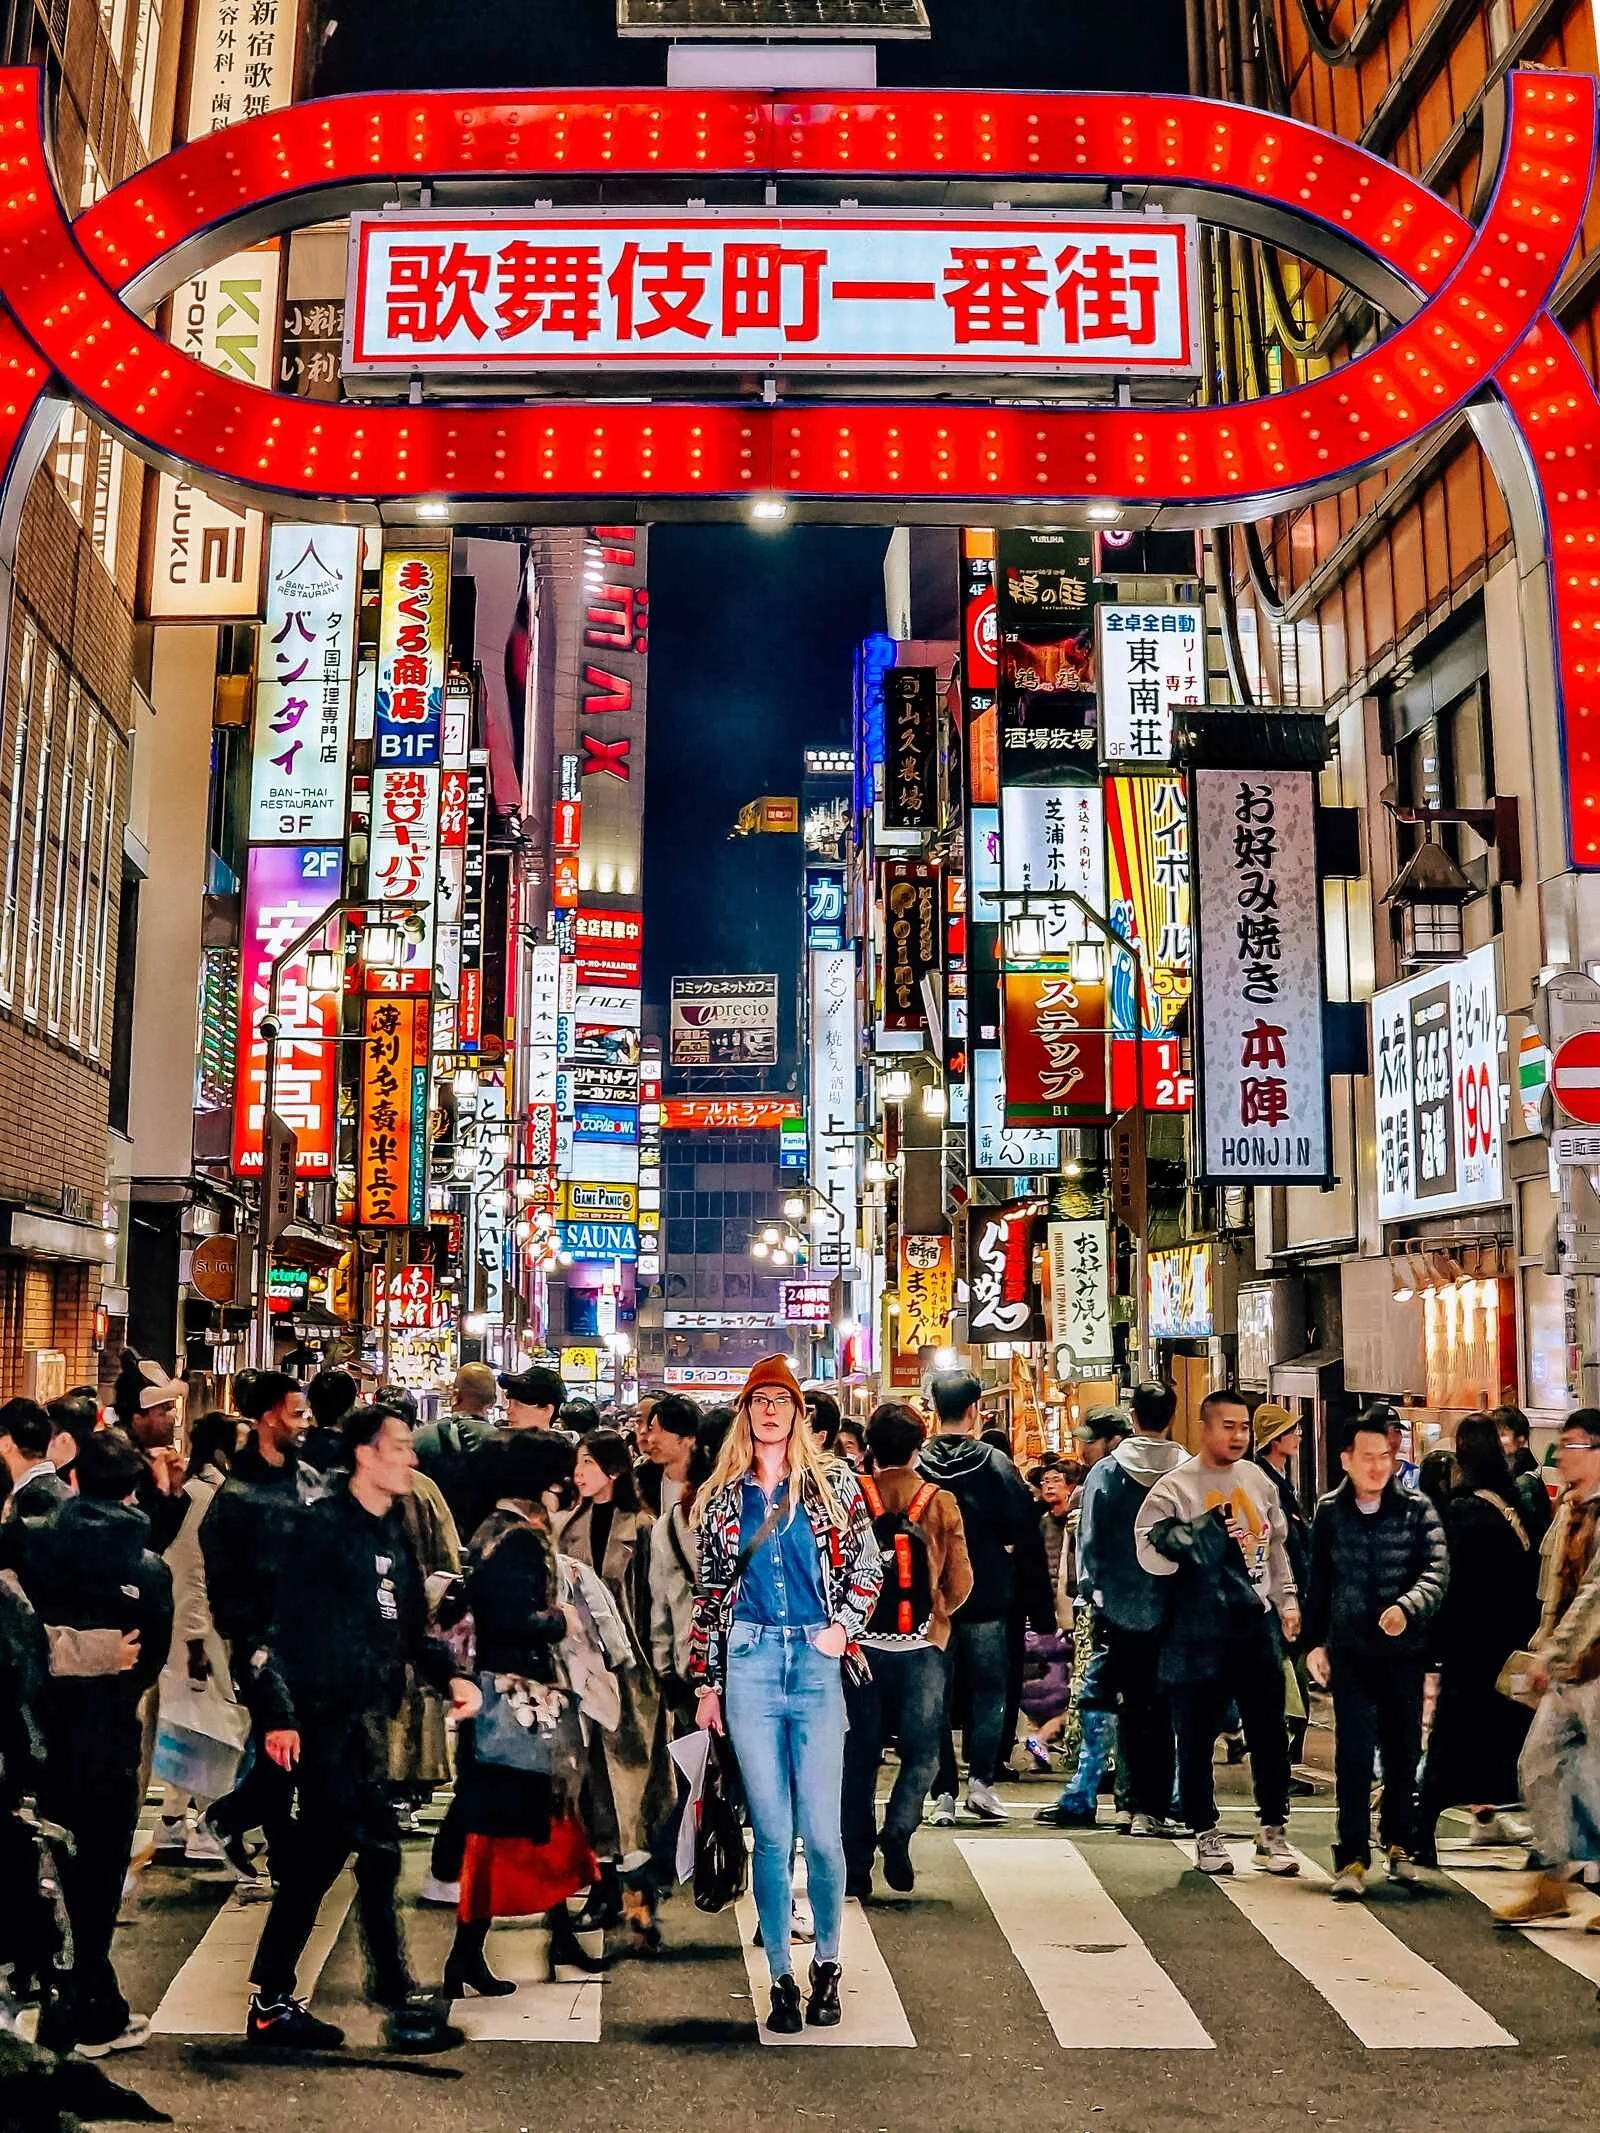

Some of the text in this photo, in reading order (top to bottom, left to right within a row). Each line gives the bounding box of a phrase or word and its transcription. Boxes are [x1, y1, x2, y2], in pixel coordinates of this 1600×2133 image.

[210, 0, 240, 131] 容外科・歯科
[386, 241, 1160, 346] 歌舞伎町一番街
[281, 352, 342, 383] い利
[277, 583, 341, 599] RESTAURANT
[285, 579, 332, 592] BAN-THAI
[969, 584, 986, 595] 4F
[1106, 613, 1195, 633] 全卓全自動
[390, 561, 431, 721] まぐろ商店
[269, 611, 316, 775] バンタイ
[320, 611, 342, 763] タイ国料理専門店
[1126, 638, 1162, 756] 東南荘
[380, 734, 434, 758] B1F
[1005, 728, 1097, 750] 酒場牧場
[1110, 743, 1126, 756] 3F
[260, 798, 335, 809] RESTAURANT
[269, 788, 328, 798] BAN-THAI
[278, 815, 313, 833] 3F
[302, 851, 339, 878] 2F
[1045, 797, 1067, 937] 芝浦ホルモン
[1153, 784, 1190, 962] ハイボール
[1232, 781, 1281, 1005] お好み焼き
[380, 971, 414, 991] 4F
[576, 995, 638, 1010] FACE
[1034, 978, 1084, 1100] ステップ
[1240, 1018, 1290, 1130] 本陣
[704, 1115, 758, 1126] ハンバーグ
[240, 1151, 329, 1166] ANUTEI
[1030, 1153, 1055, 1166] B1F
[1222, 1137, 1310, 1169] HONJIN
[573, 1187, 622, 1206] GAME PANIC
[567, 1224, 637, 1249] SAUNA
[1070, 1231, 1106, 1345] お好み焼き
[1082, 1364, 1113, 1377] B1F
